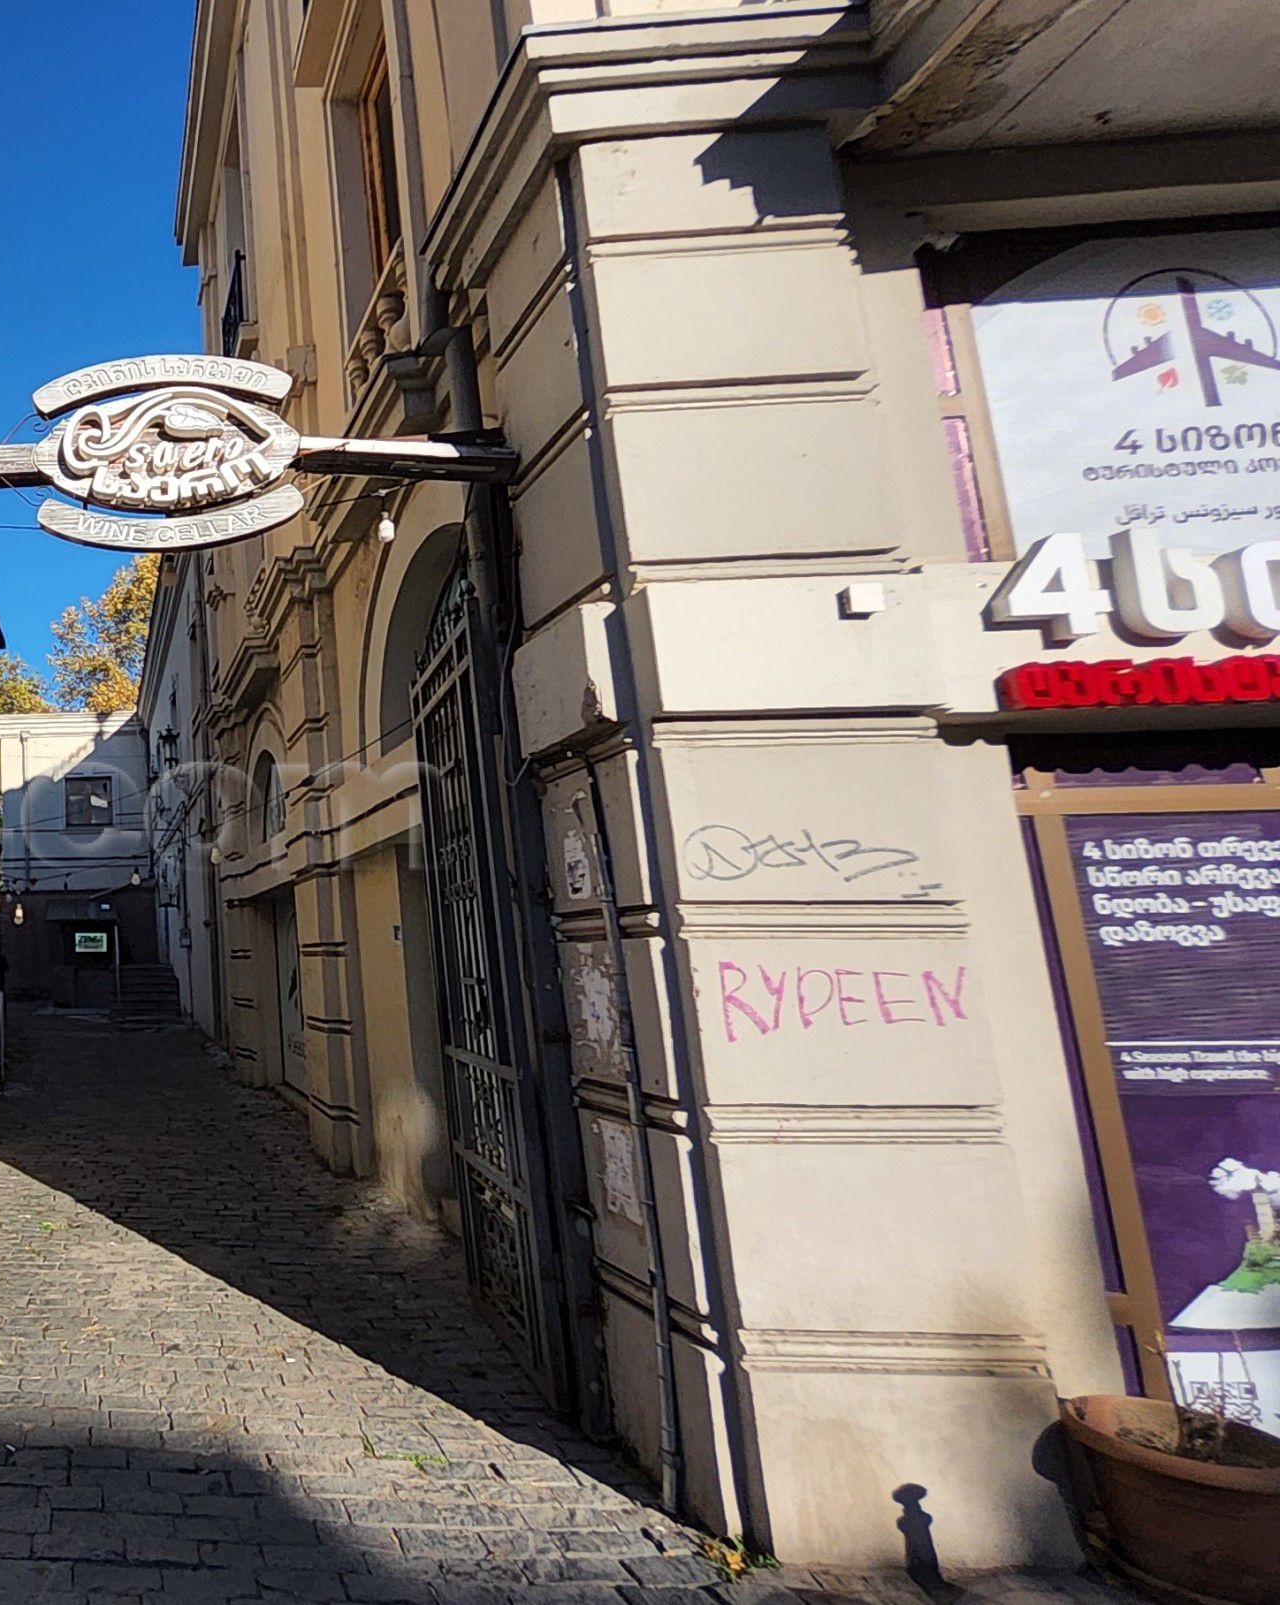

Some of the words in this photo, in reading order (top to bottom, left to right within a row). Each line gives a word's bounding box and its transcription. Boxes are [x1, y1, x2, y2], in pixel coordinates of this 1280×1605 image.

[125, 437, 244, 470] saero
[1113, 429, 1144, 455] 4
[1245, 456, 1280, 475] კო
[77, 513, 147, 544] WINE
[156, 504, 267, 543] CELLAR
[1082, 841, 1103, 860] 4
